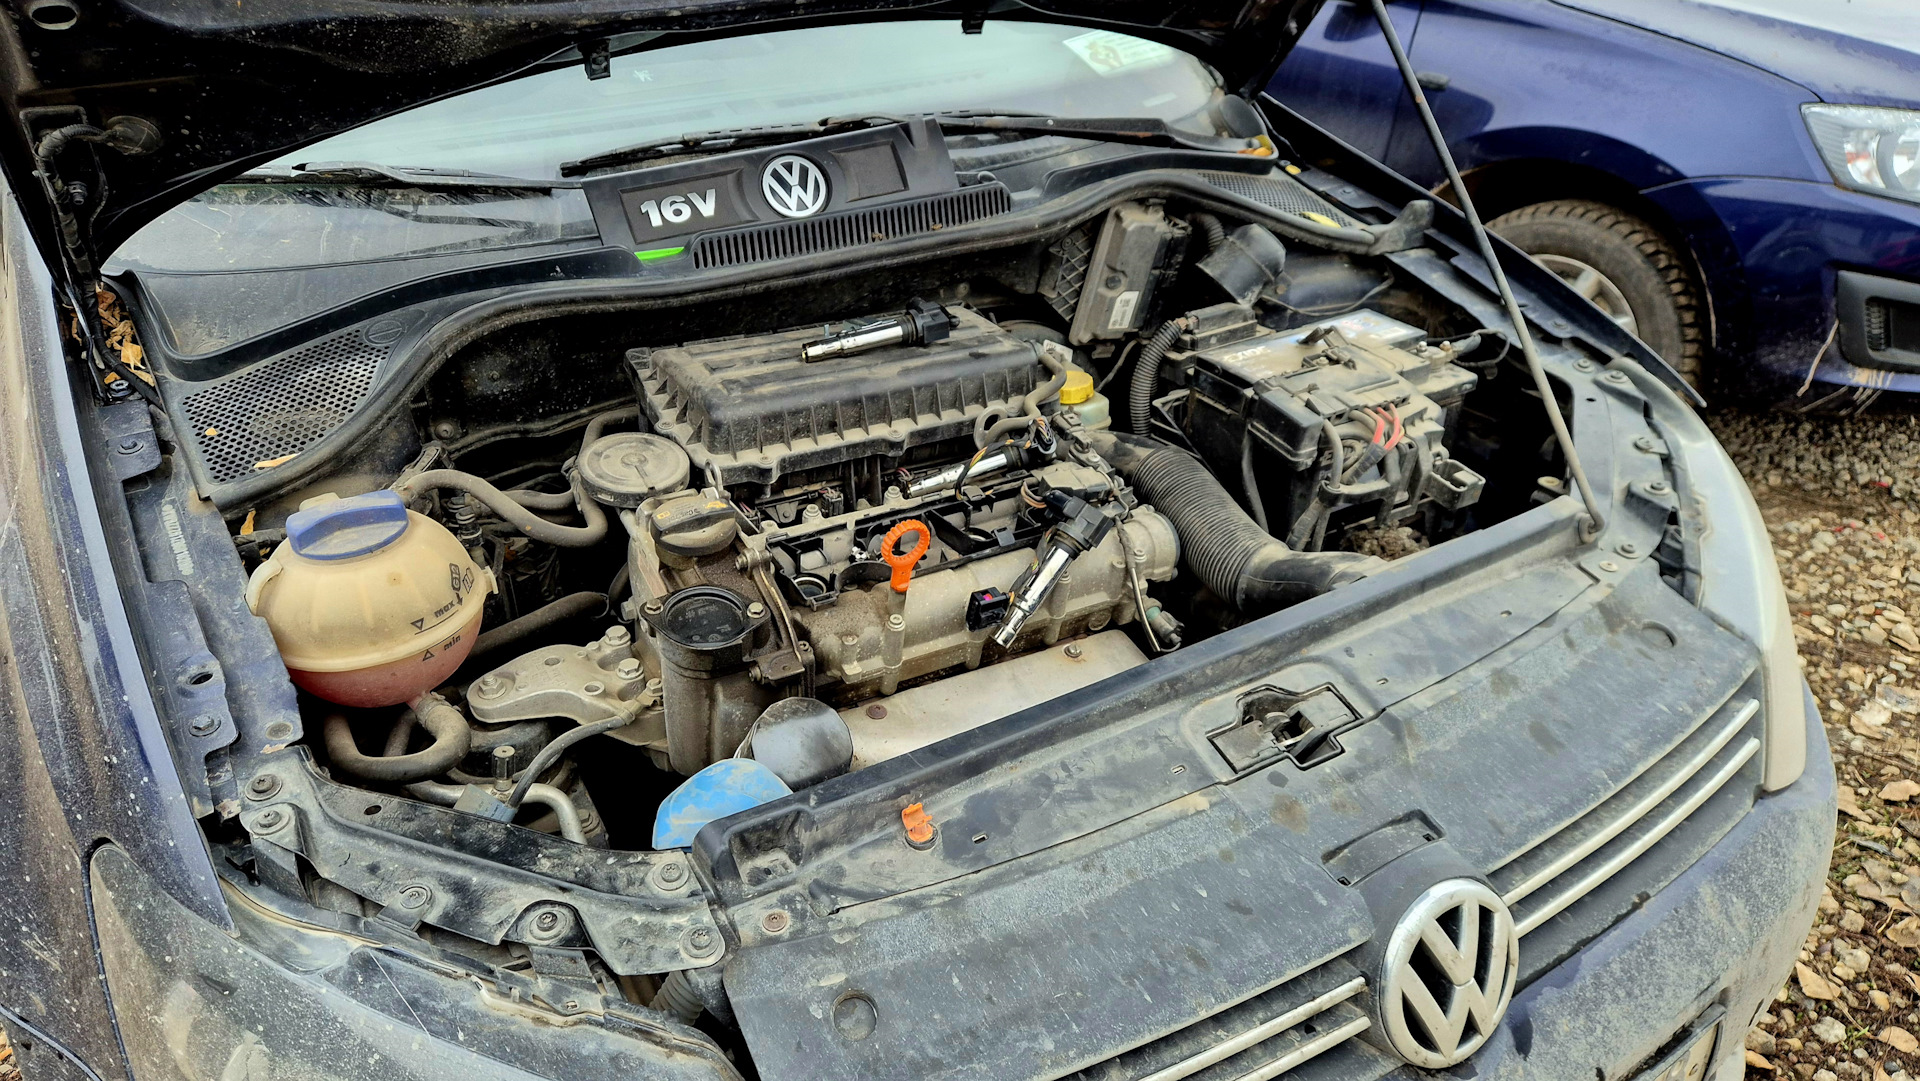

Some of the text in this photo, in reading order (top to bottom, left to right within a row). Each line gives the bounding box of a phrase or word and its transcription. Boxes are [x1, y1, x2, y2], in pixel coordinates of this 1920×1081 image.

[762, 155, 827, 217] VW
[639, 188, 716, 227] 16V
[450, 565, 461, 589] G12
[434, 600, 455, 618] max
[443, 635, 461, 651] min
[1380, 878, 1520, 1070] VW
